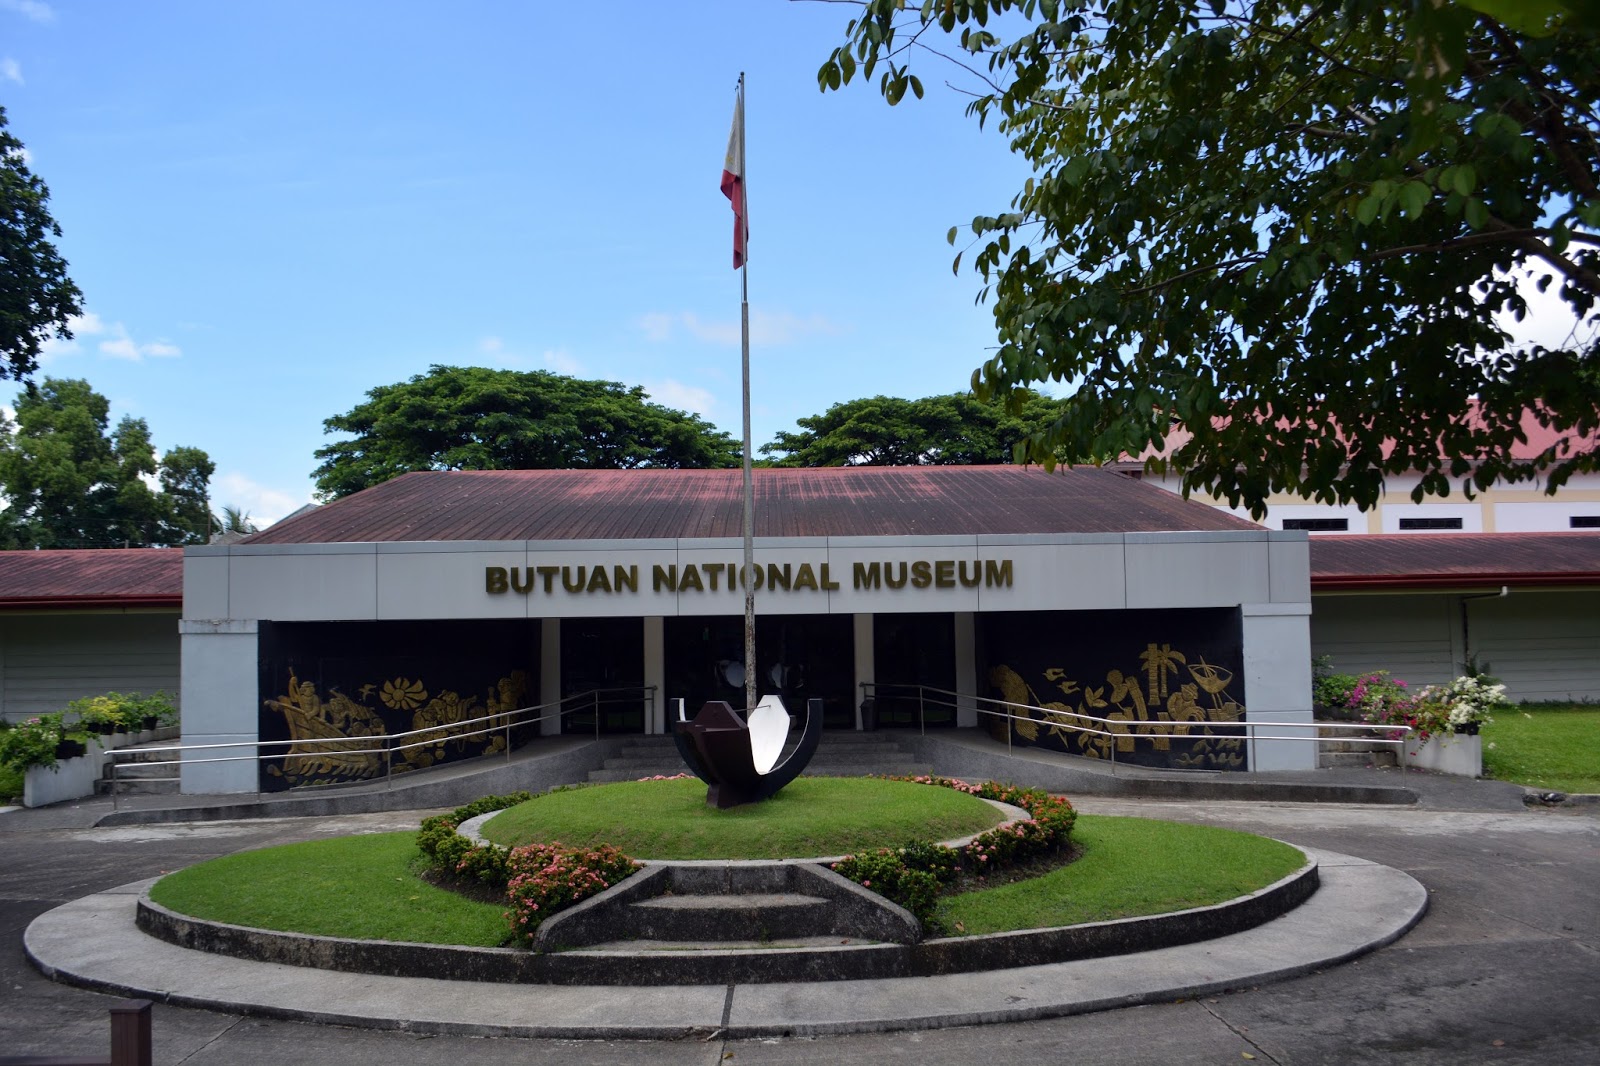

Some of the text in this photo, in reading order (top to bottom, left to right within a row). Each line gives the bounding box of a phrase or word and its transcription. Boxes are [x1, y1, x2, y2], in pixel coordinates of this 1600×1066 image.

[485, 560, 1014, 595] BUTUAN NATIONAL MUSEUM
